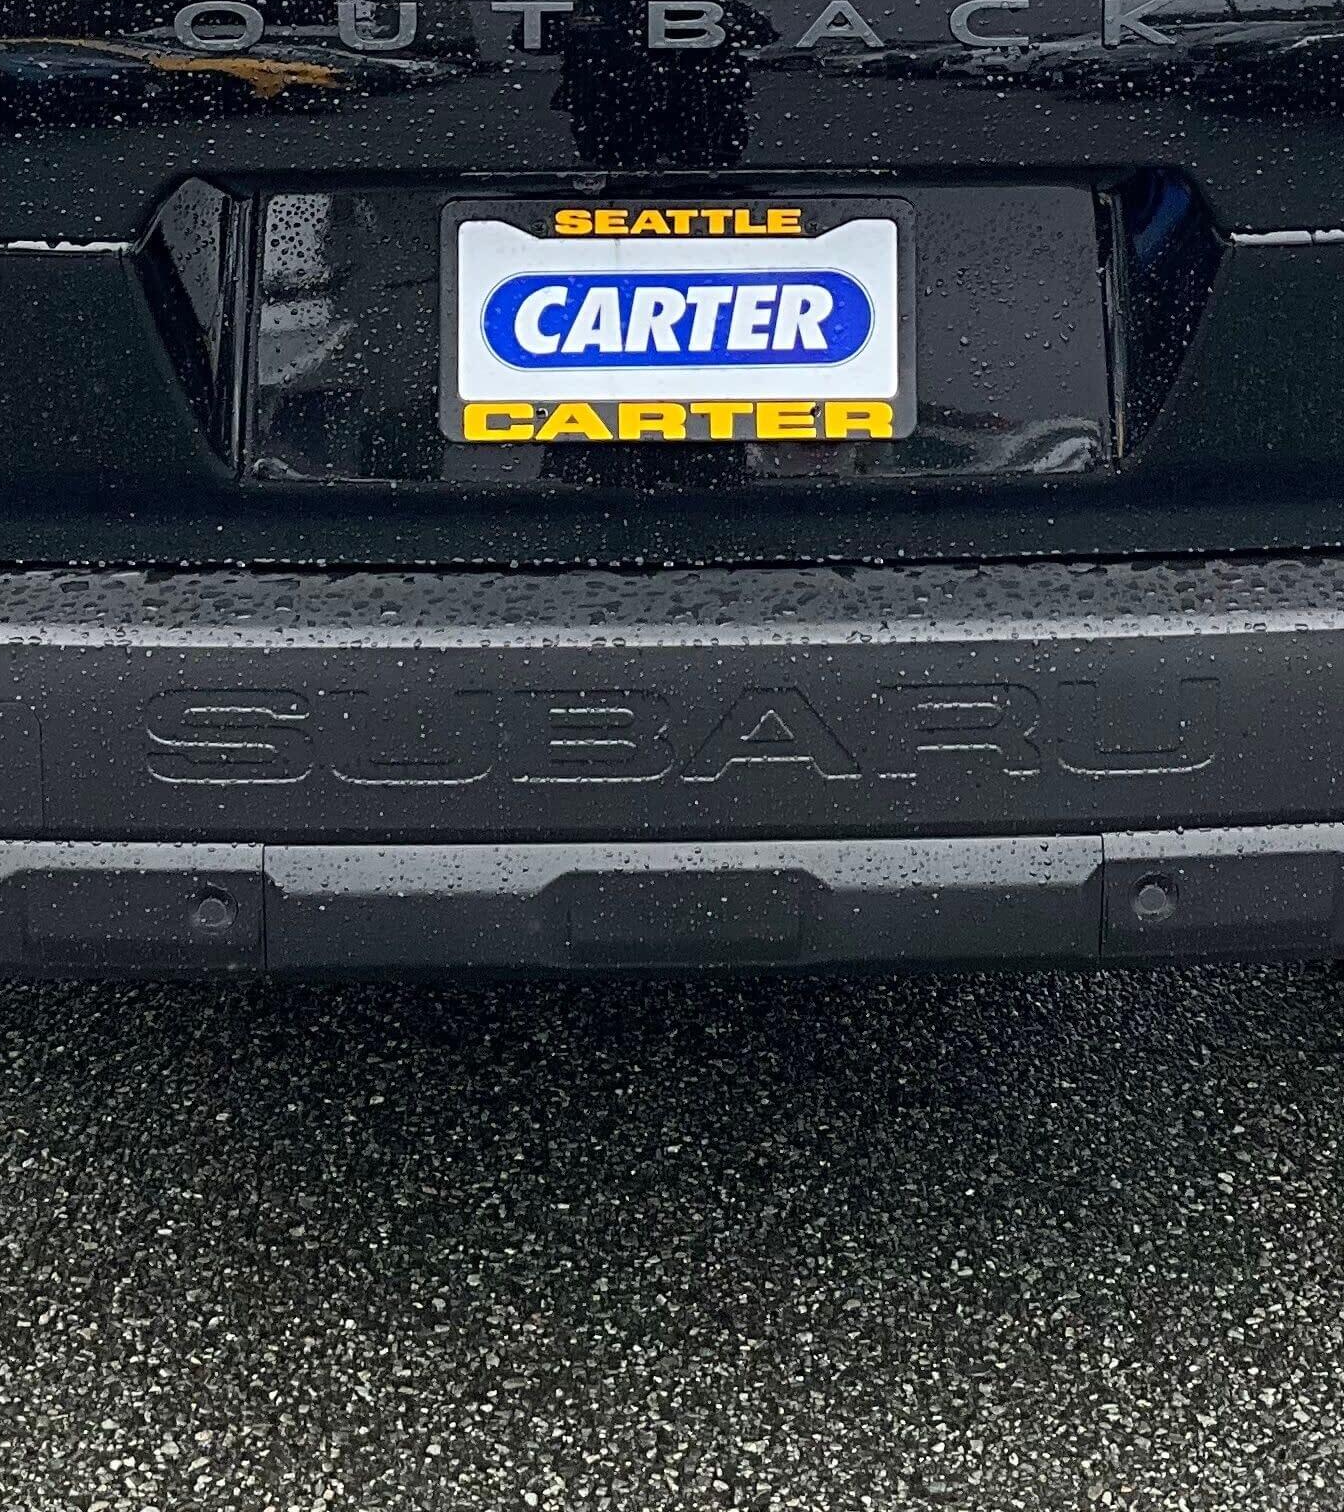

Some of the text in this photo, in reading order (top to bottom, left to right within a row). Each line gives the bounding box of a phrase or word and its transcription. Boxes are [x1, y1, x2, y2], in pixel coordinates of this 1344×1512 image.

[554, 208, 802, 235] SEATTLE
[513, 284, 834, 355] CARTER
[463, 401, 894, 441] CARTER
[144, 677, 1221, 785] SUBARU
